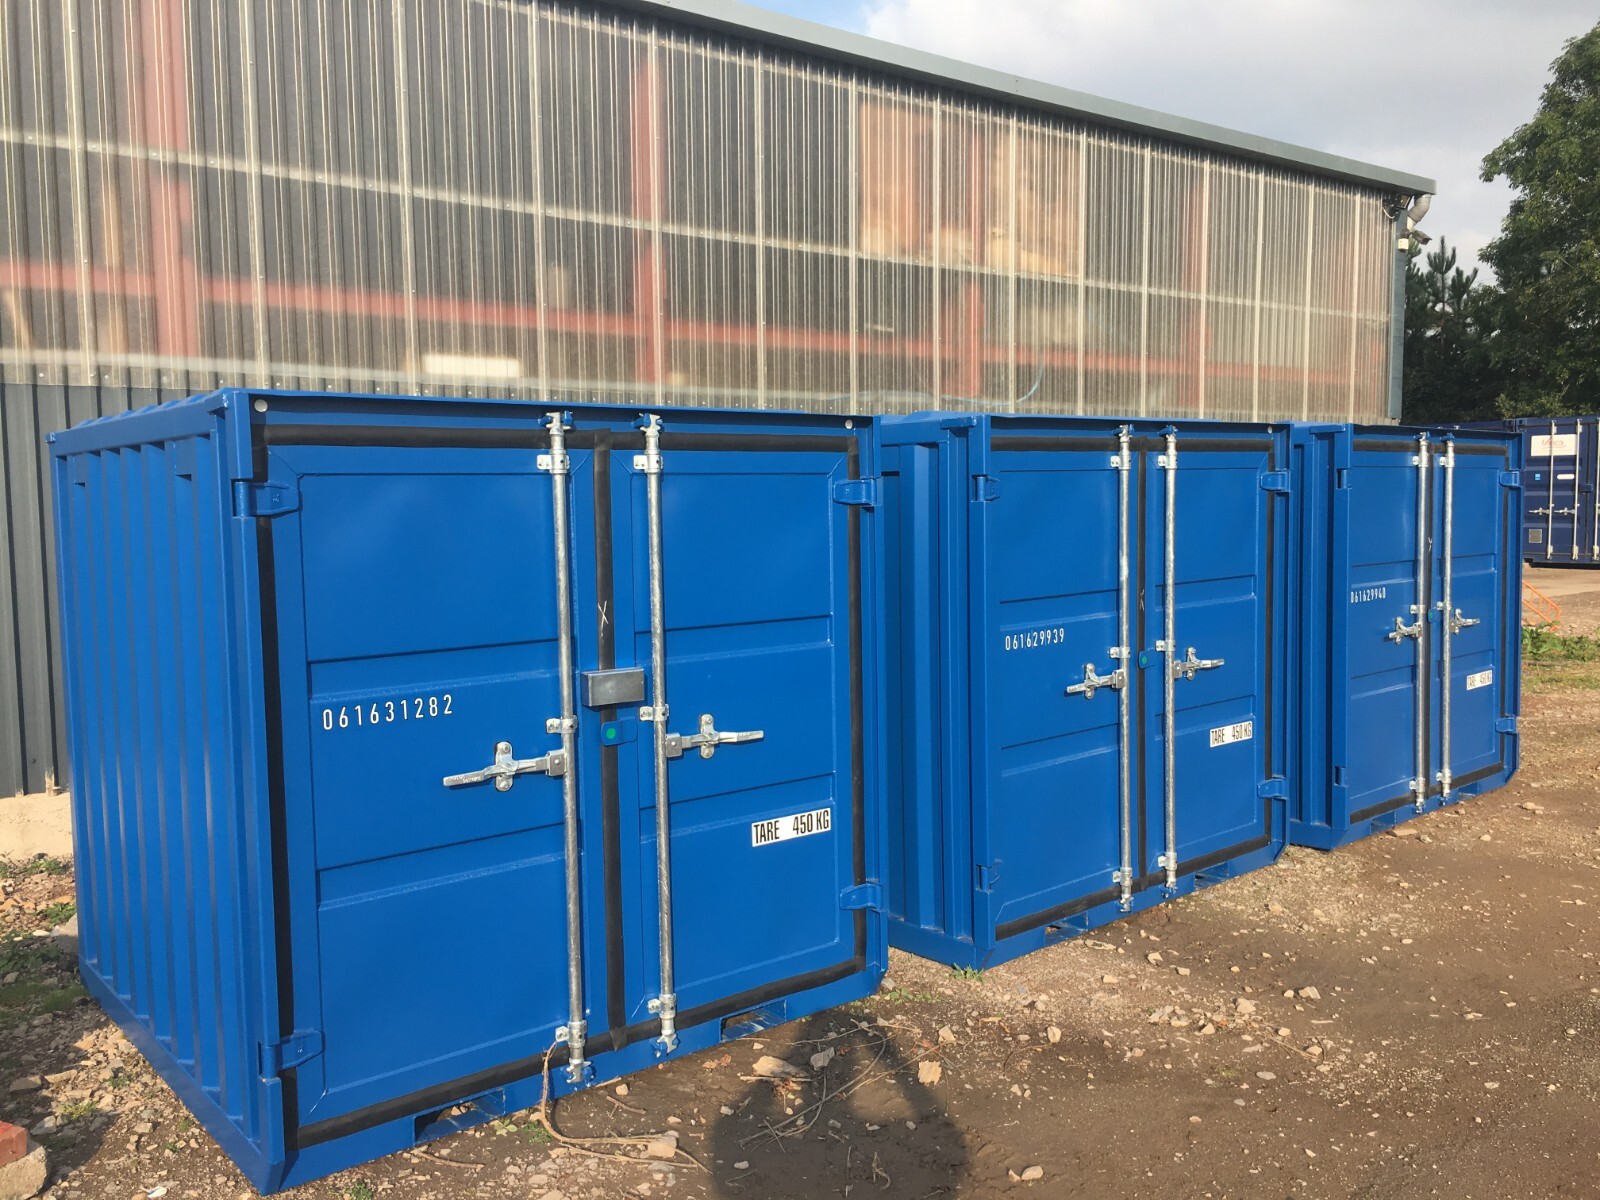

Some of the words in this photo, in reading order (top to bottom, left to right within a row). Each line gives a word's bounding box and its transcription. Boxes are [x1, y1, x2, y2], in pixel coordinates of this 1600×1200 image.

[1350, 587, 1386, 604] 061629940
[1005, 628, 1065, 651] 061629939
[322, 694, 453, 731] 061631282
[1211, 728, 1225, 746] TARE
[1232, 724, 1243, 740] 450
[1243, 722, 1252, 738] KG
[753, 820, 780, 844] TARE
[792, 813, 814, 835] 450
[816, 809, 830, 831] KG
